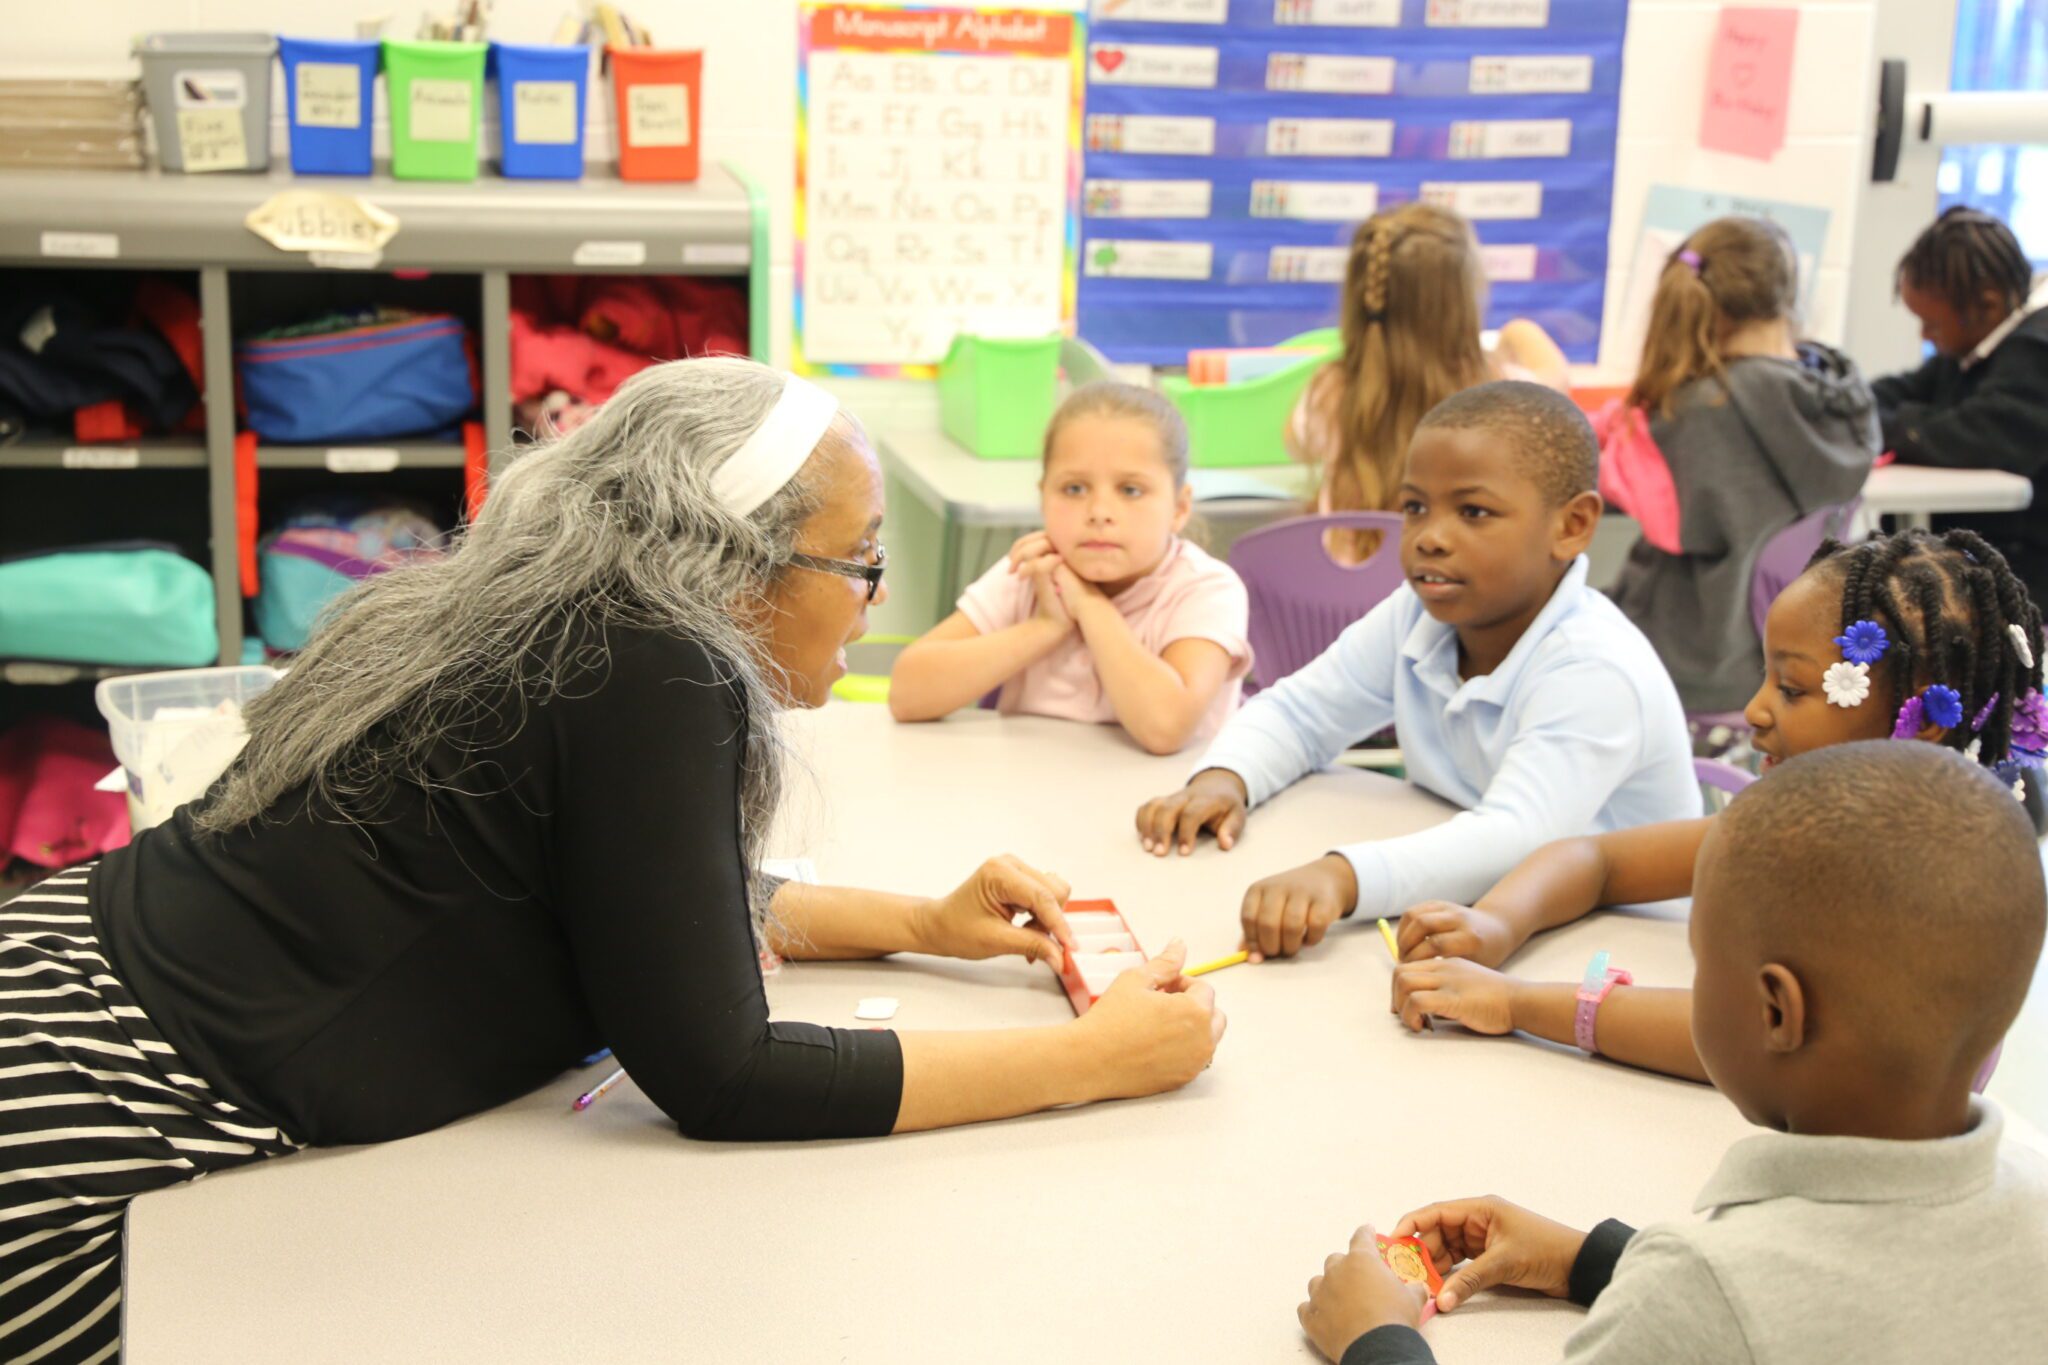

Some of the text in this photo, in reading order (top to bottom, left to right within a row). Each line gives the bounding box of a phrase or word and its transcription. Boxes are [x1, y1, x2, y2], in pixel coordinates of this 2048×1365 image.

[833, 9, 1047, 49] Manuscript Alphabet
[826, 61, 1052, 97] Aa Bb Cc Dd
[826, 101, 1049, 147] Ee Ff Gg Hh
[826, 144, 1049, 188] Ii Jj Kk Ll
[818, 189, 1052, 238] Mm Nn Oo Pp
[824, 230, 1044, 277] Qq Rr Ss Tt
[816, 274, 859, 304] Uu
[876, 274, 912, 304] Vv
